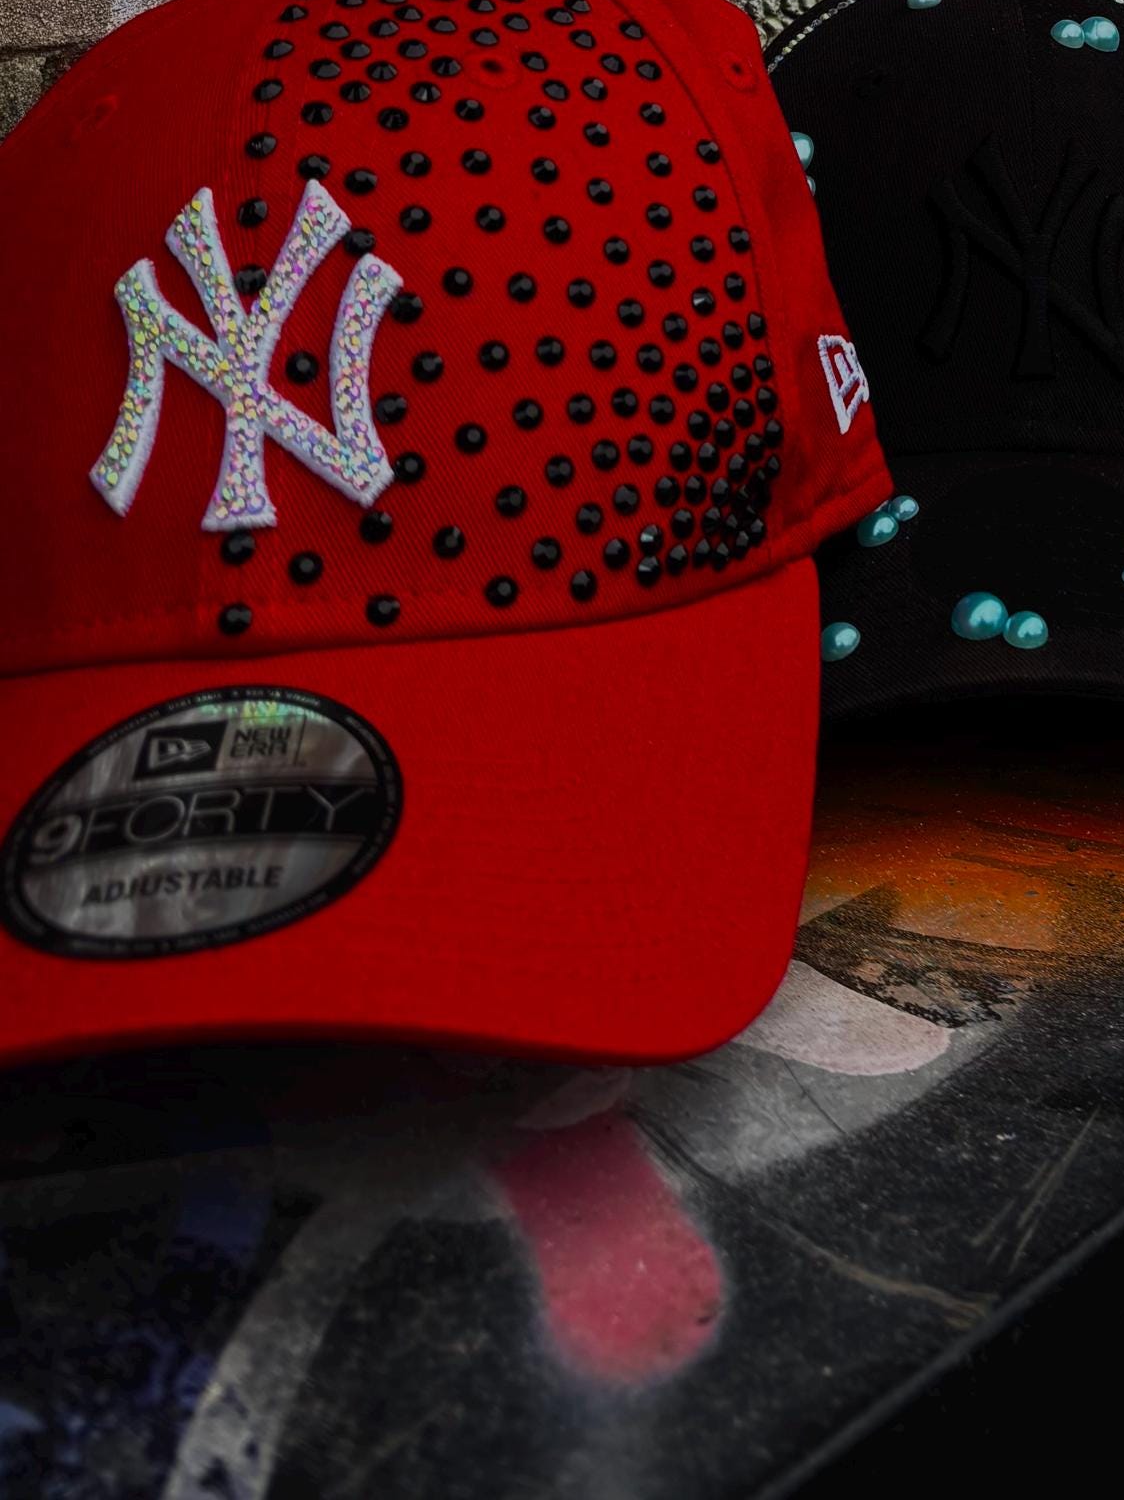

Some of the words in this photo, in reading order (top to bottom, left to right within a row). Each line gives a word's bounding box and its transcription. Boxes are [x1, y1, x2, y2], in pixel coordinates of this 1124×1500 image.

[88, 178, 405, 532] NY
[232, 727, 291, 743] NEW
[27, 785, 376, 864] 9FORTY
[82, 865, 284, 907] ADJUSTABLE
